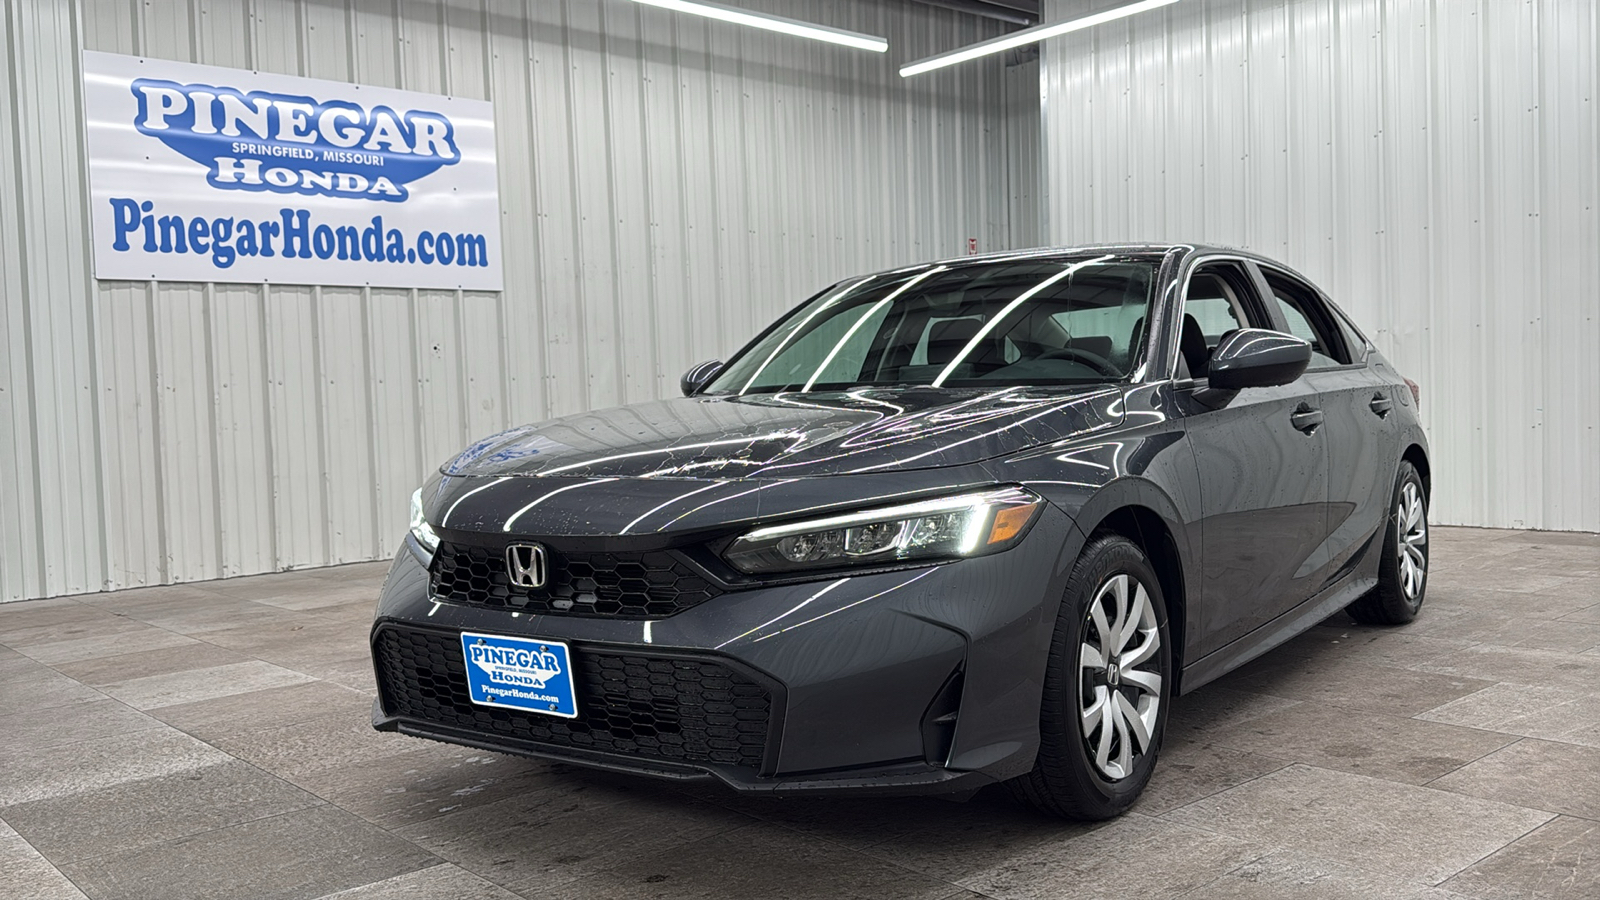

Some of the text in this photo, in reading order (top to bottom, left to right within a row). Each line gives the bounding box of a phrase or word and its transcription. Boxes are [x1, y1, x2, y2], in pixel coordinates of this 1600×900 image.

[139, 86, 455, 160] PINEGAR
[231, 141, 385, 167] SPRINGFIELD, MISSOURI
[214, 156, 403, 197] HONDA
[109, 197, 489, 269] PinegarHonda.com
[471, 646, 559, 672] PINEGAR
[491, 670, 544, 687] HONDA
[481, 684, 560, 703] PinegarHonda.com
